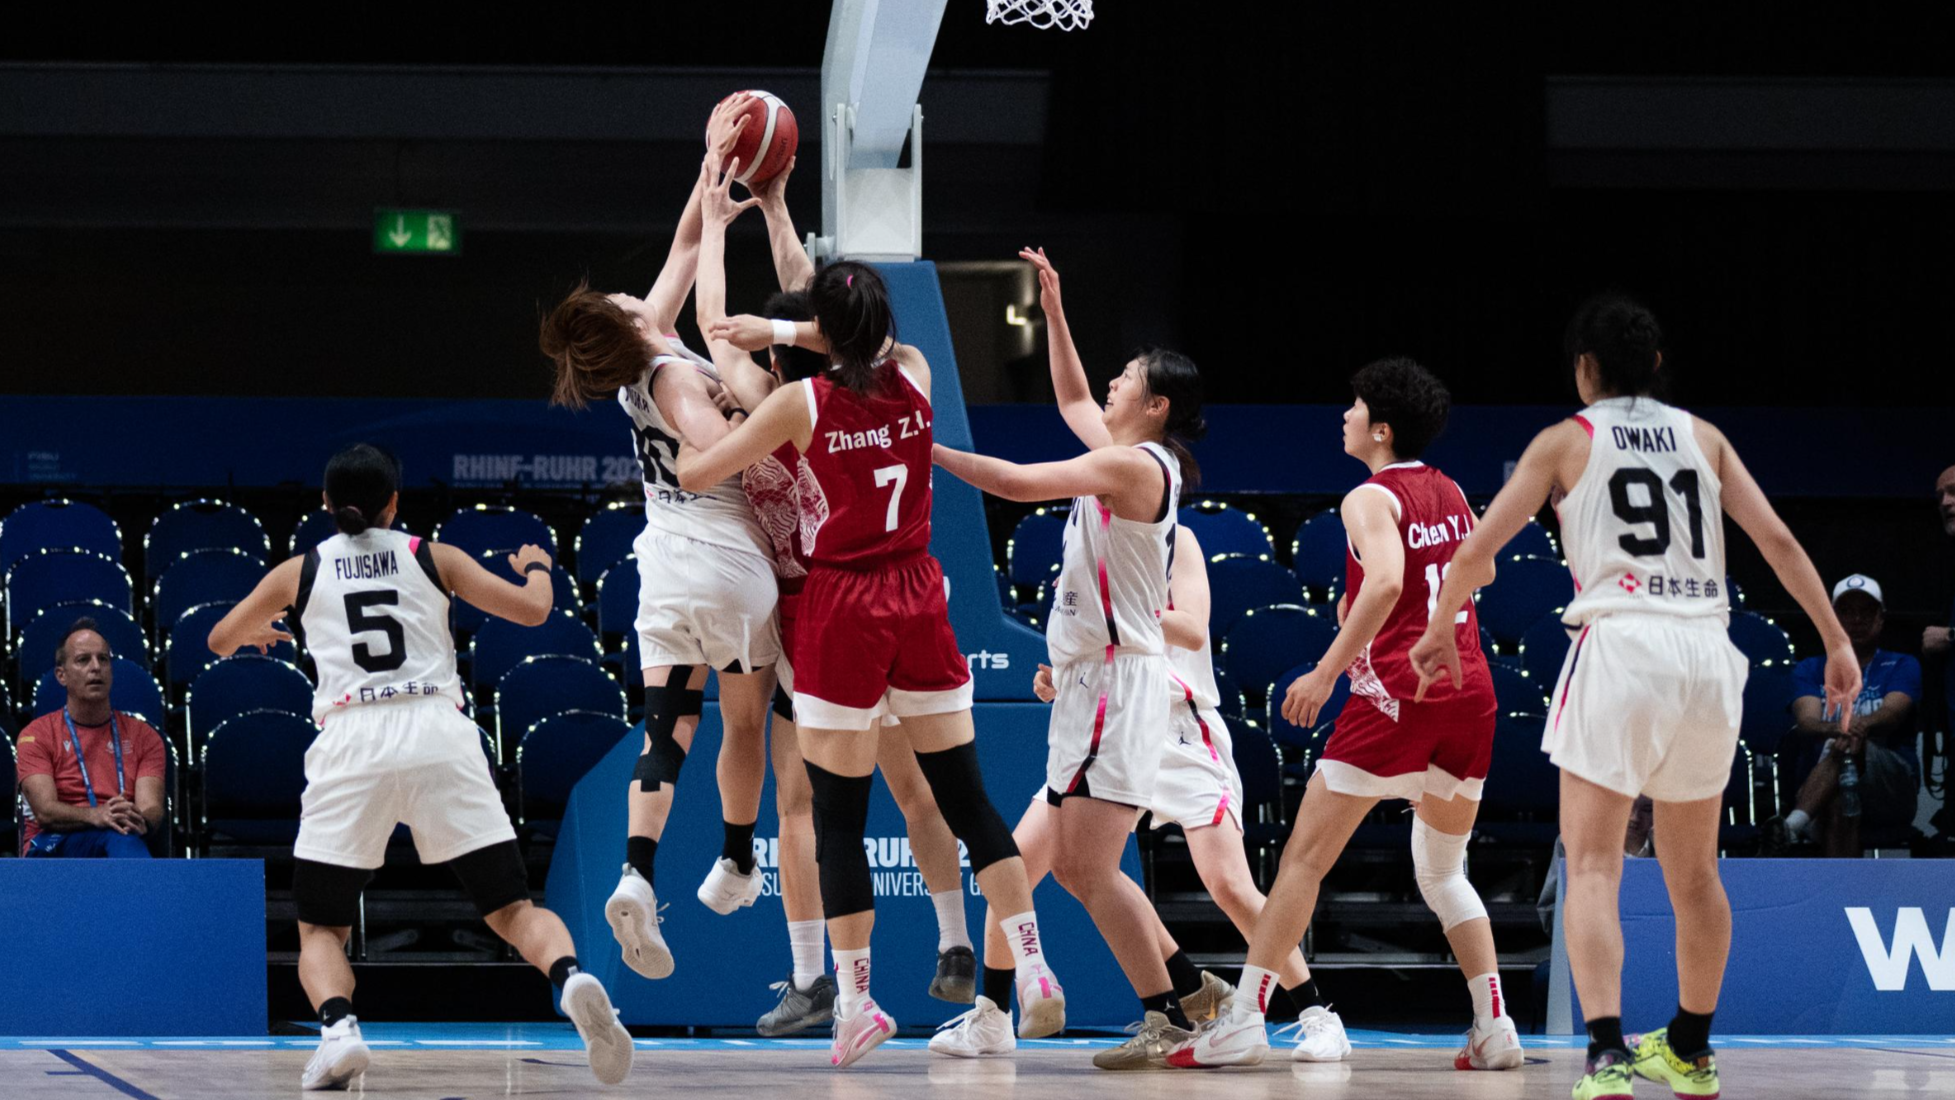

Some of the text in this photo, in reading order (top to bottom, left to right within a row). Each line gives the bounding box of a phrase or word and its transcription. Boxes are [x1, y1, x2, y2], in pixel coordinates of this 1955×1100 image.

[824, 423, 893, 454] Zhang
[1611, 426, 1677, 453] OWAKI
[602, 455, 643, 482] 202
[873, 463, 909, 534] 7
[1608, 467, 1706, 560] 91
[1407, 521, 1451, 550] Chen
[334, 550, 399, 580] FUJISAWA
[1649, 574, 1719, 598] 日本生命
[343, 589, 408, 674] 5
[1843, 906, 1955, 992] W
[854, 957, 869, 994] CHINA
